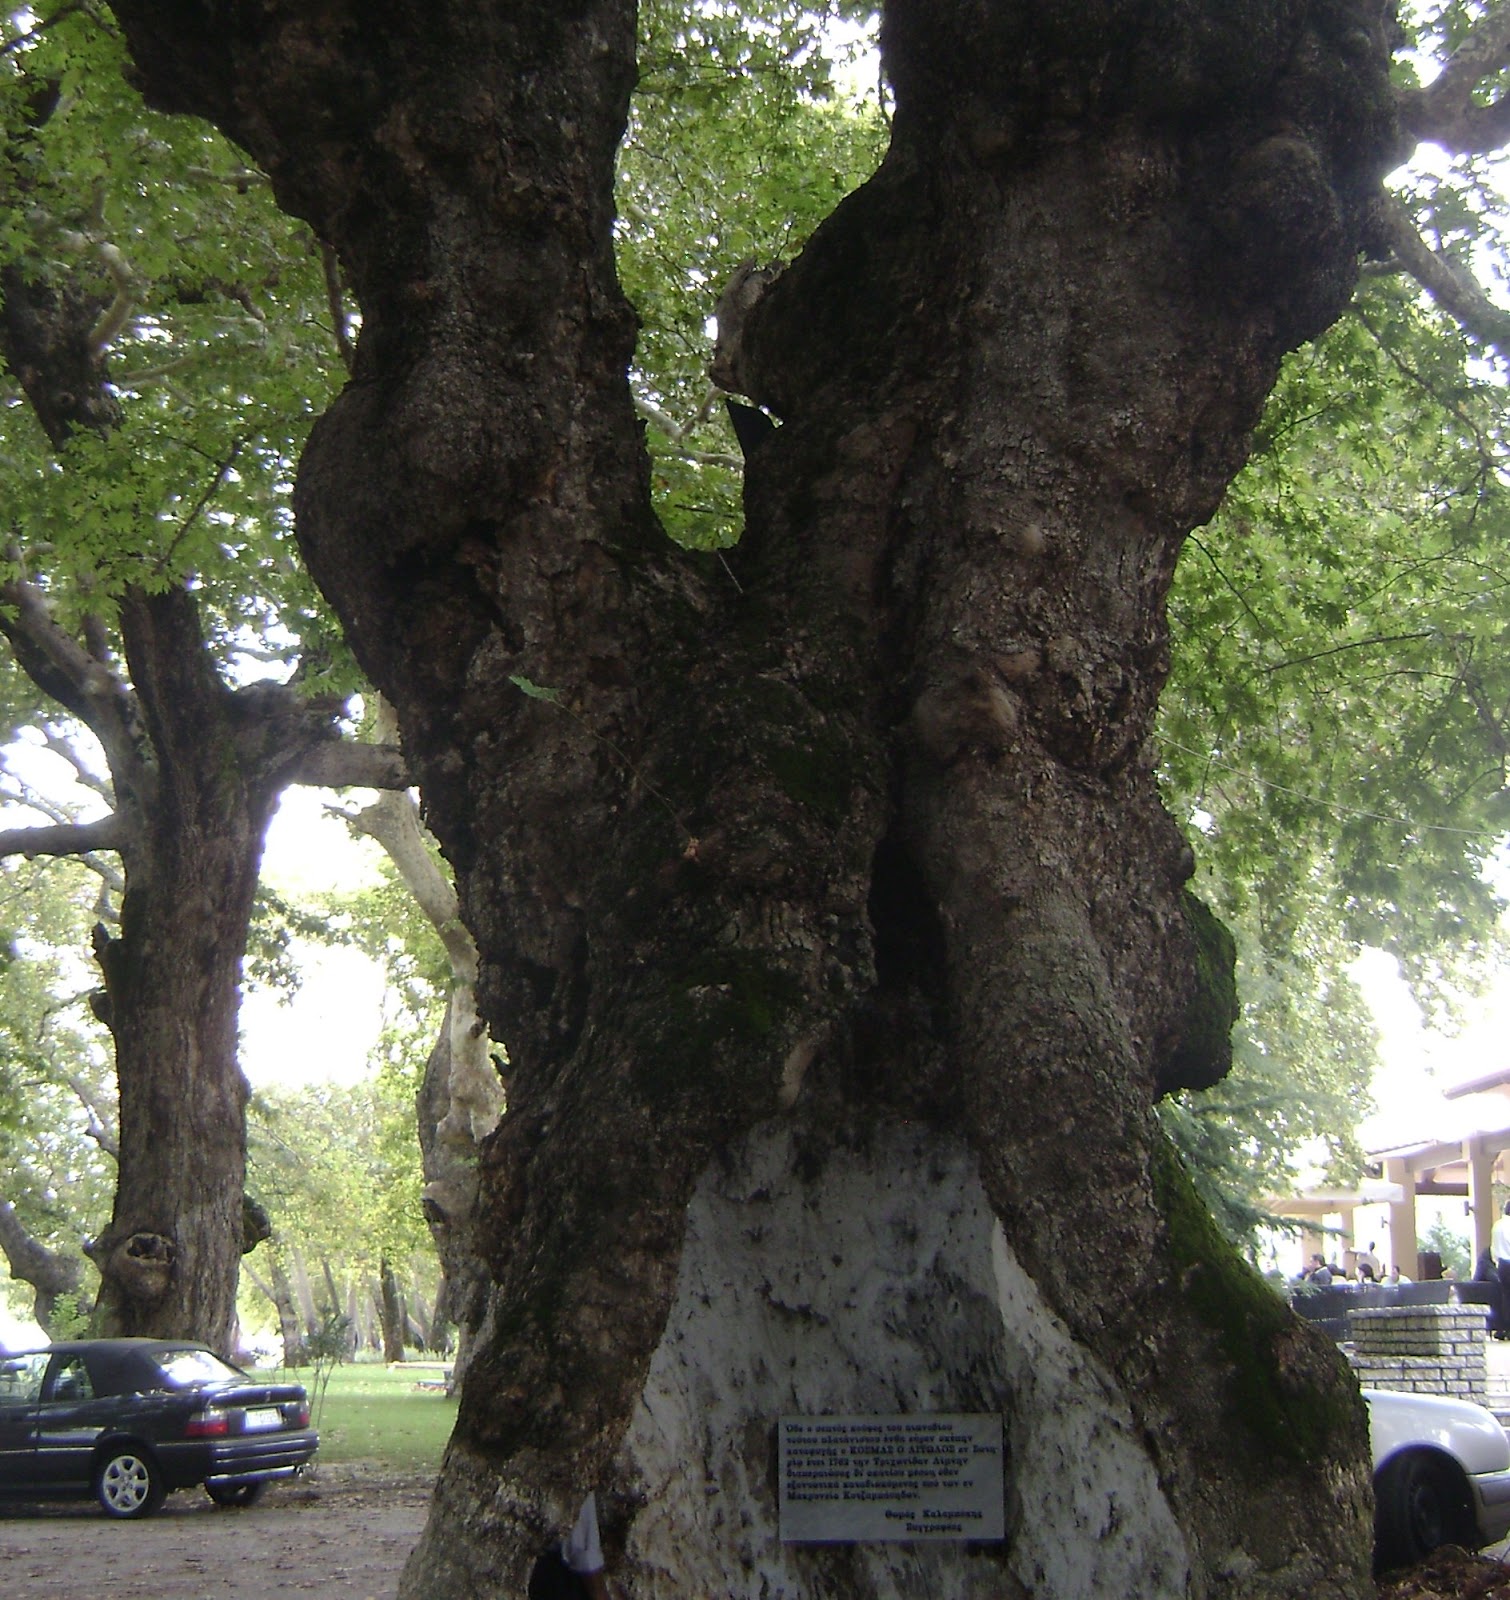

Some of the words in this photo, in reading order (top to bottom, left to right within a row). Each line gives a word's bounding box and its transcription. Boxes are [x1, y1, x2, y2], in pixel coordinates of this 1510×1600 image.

[850, 1445, 894, 1454] ΚΟΣΜΑΣ
[897, 1445, 904, 1454] Ο
[908, 1445, 955, 1454] ΑΙΤΩΛΟΣ
